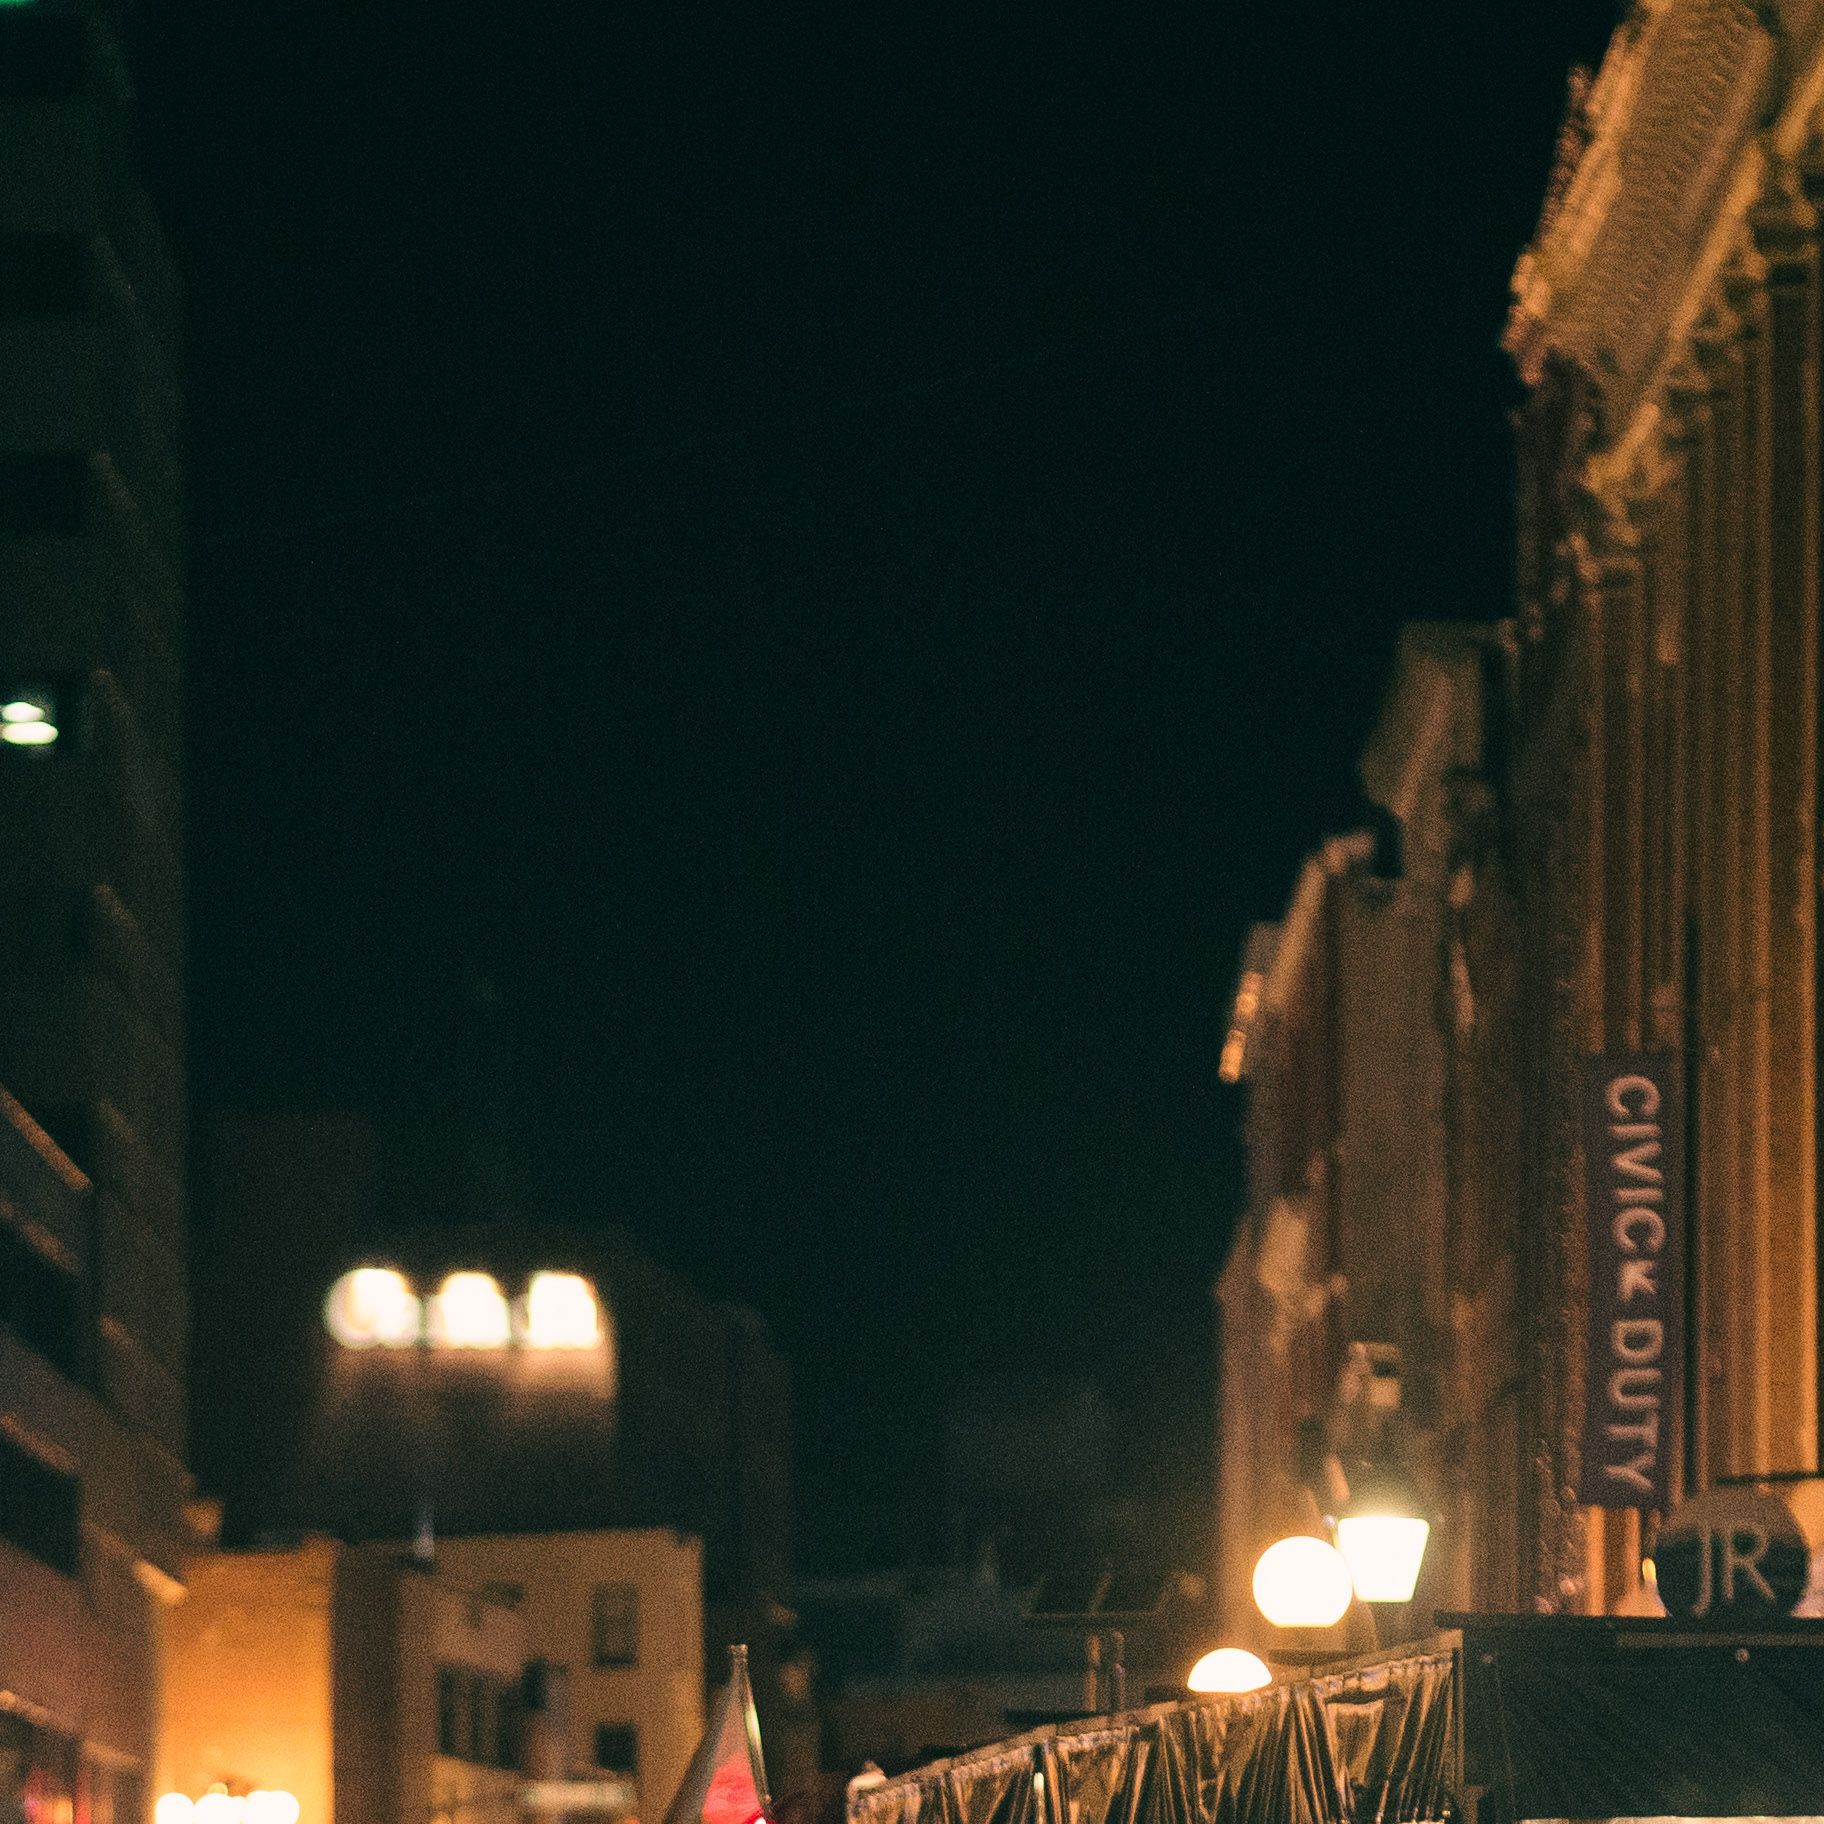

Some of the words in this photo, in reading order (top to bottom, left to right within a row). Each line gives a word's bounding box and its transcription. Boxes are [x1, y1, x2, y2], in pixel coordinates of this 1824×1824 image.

[1603, 1073, 1667, 1253] CIVIC
[1601, 1319, 1666, 1491] DUTY
[1690, 1520, 1776, 1617] JR
